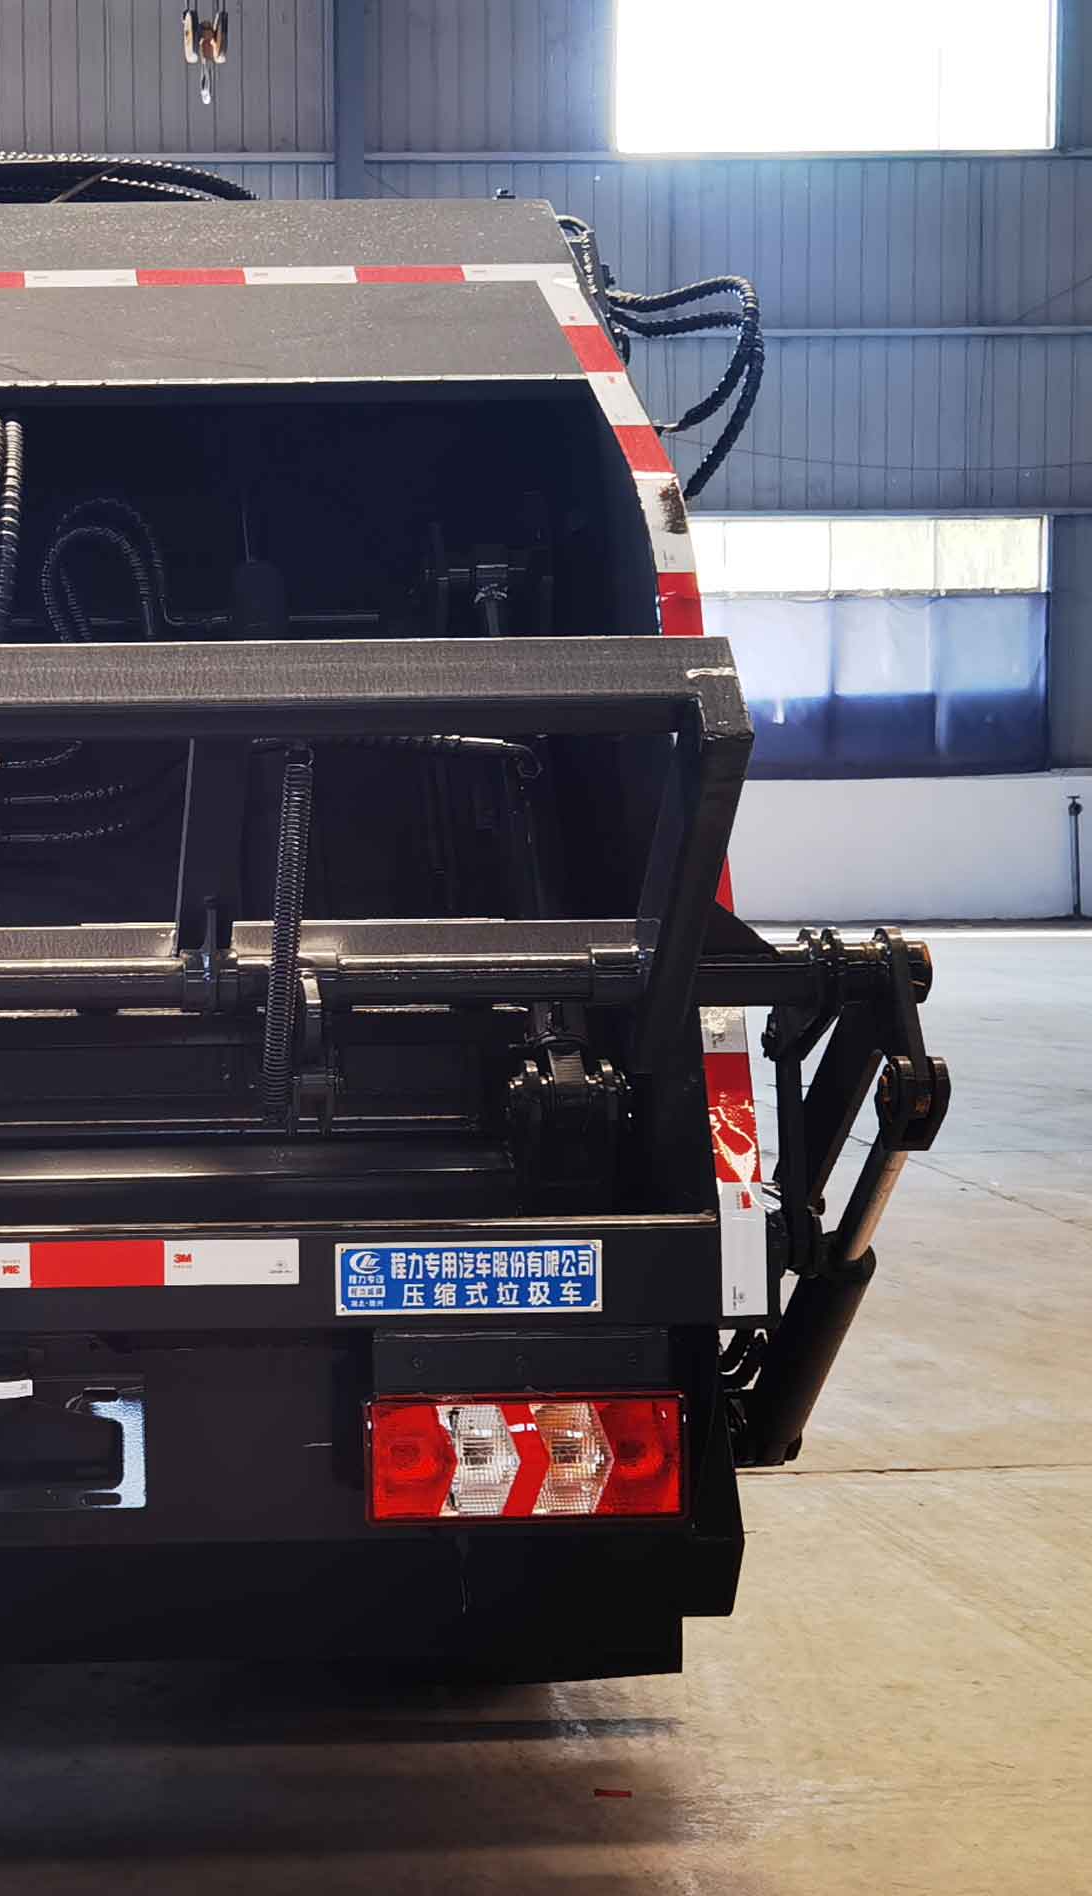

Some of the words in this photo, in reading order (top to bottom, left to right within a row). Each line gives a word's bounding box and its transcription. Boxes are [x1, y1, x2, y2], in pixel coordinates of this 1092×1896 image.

[173, 1253, 193, 1264] 3M
[390, 1250, 594, 1279] 程力专用汽车股份有限公司
[2, 1265, 21, 1275] 3M
[402, 1280, 583, 1307] 压缩式垃圾车
